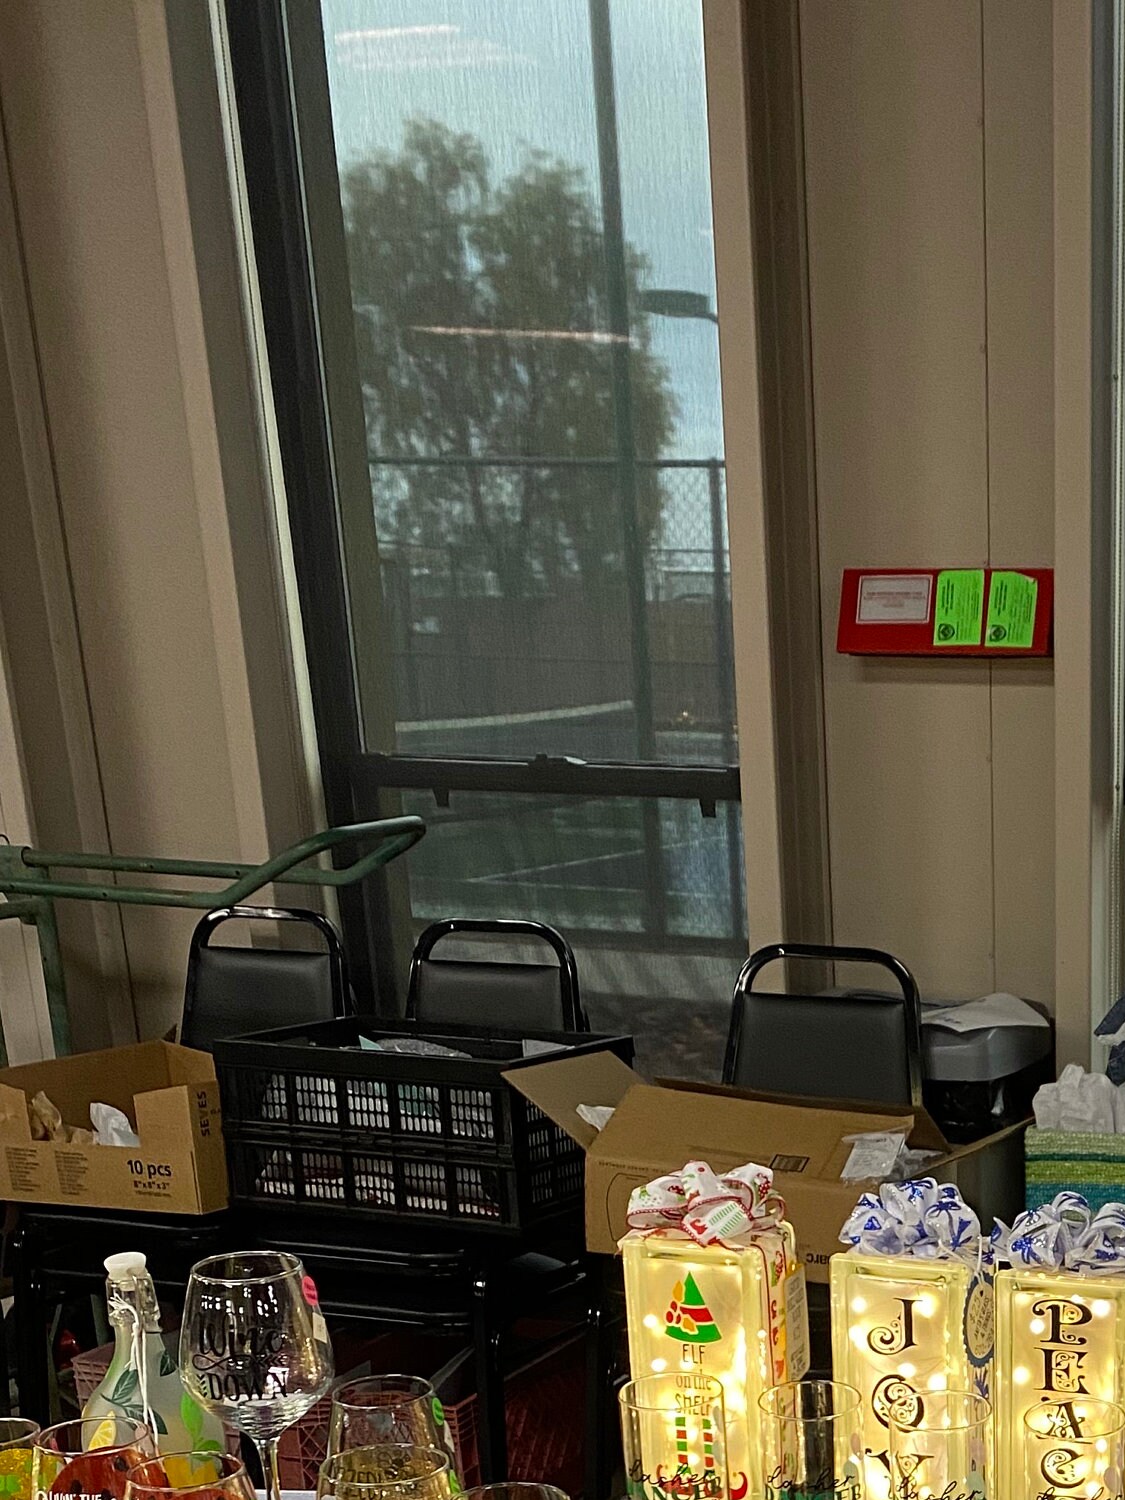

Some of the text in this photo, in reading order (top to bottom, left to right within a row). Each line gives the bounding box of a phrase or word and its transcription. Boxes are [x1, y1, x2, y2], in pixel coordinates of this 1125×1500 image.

[126, 1159, 173, 1180] 10 pcs
[682, 1343, 706, 1365] ELF
